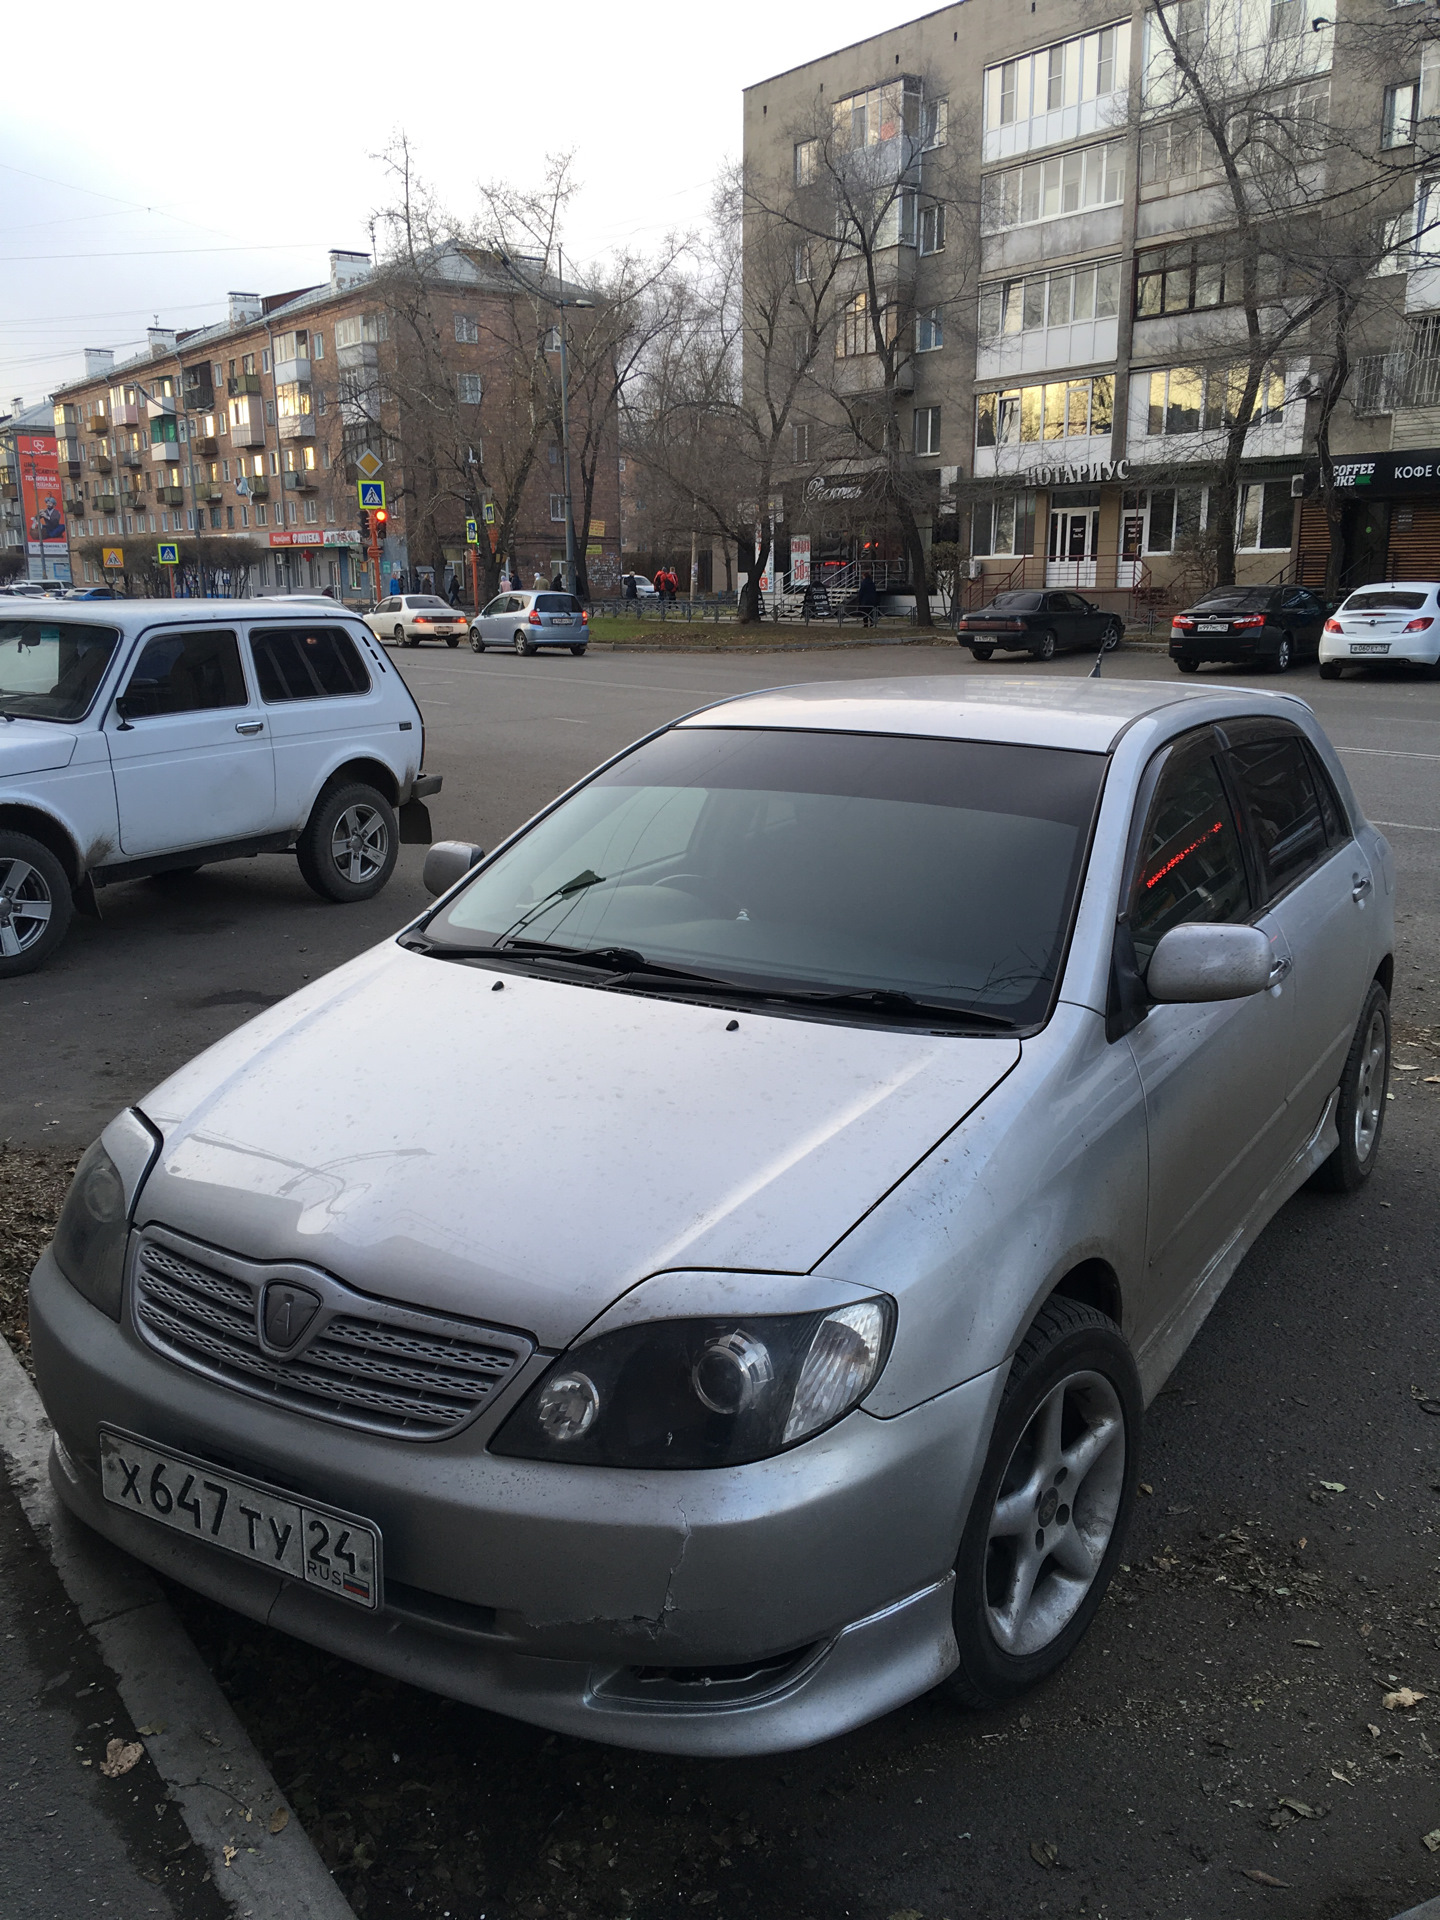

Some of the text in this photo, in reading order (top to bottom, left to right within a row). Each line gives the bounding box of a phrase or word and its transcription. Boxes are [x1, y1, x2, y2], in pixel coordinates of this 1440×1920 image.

[1025, 459, 1130, 486] НОТАРИУС
[1333, 463, 1375, 477] COFFEE
[1394, 464, 1433, 479] КОФЕ
[309, 1520, 356, 1575] 24
[307, 1560, 342, 1586] RUS
